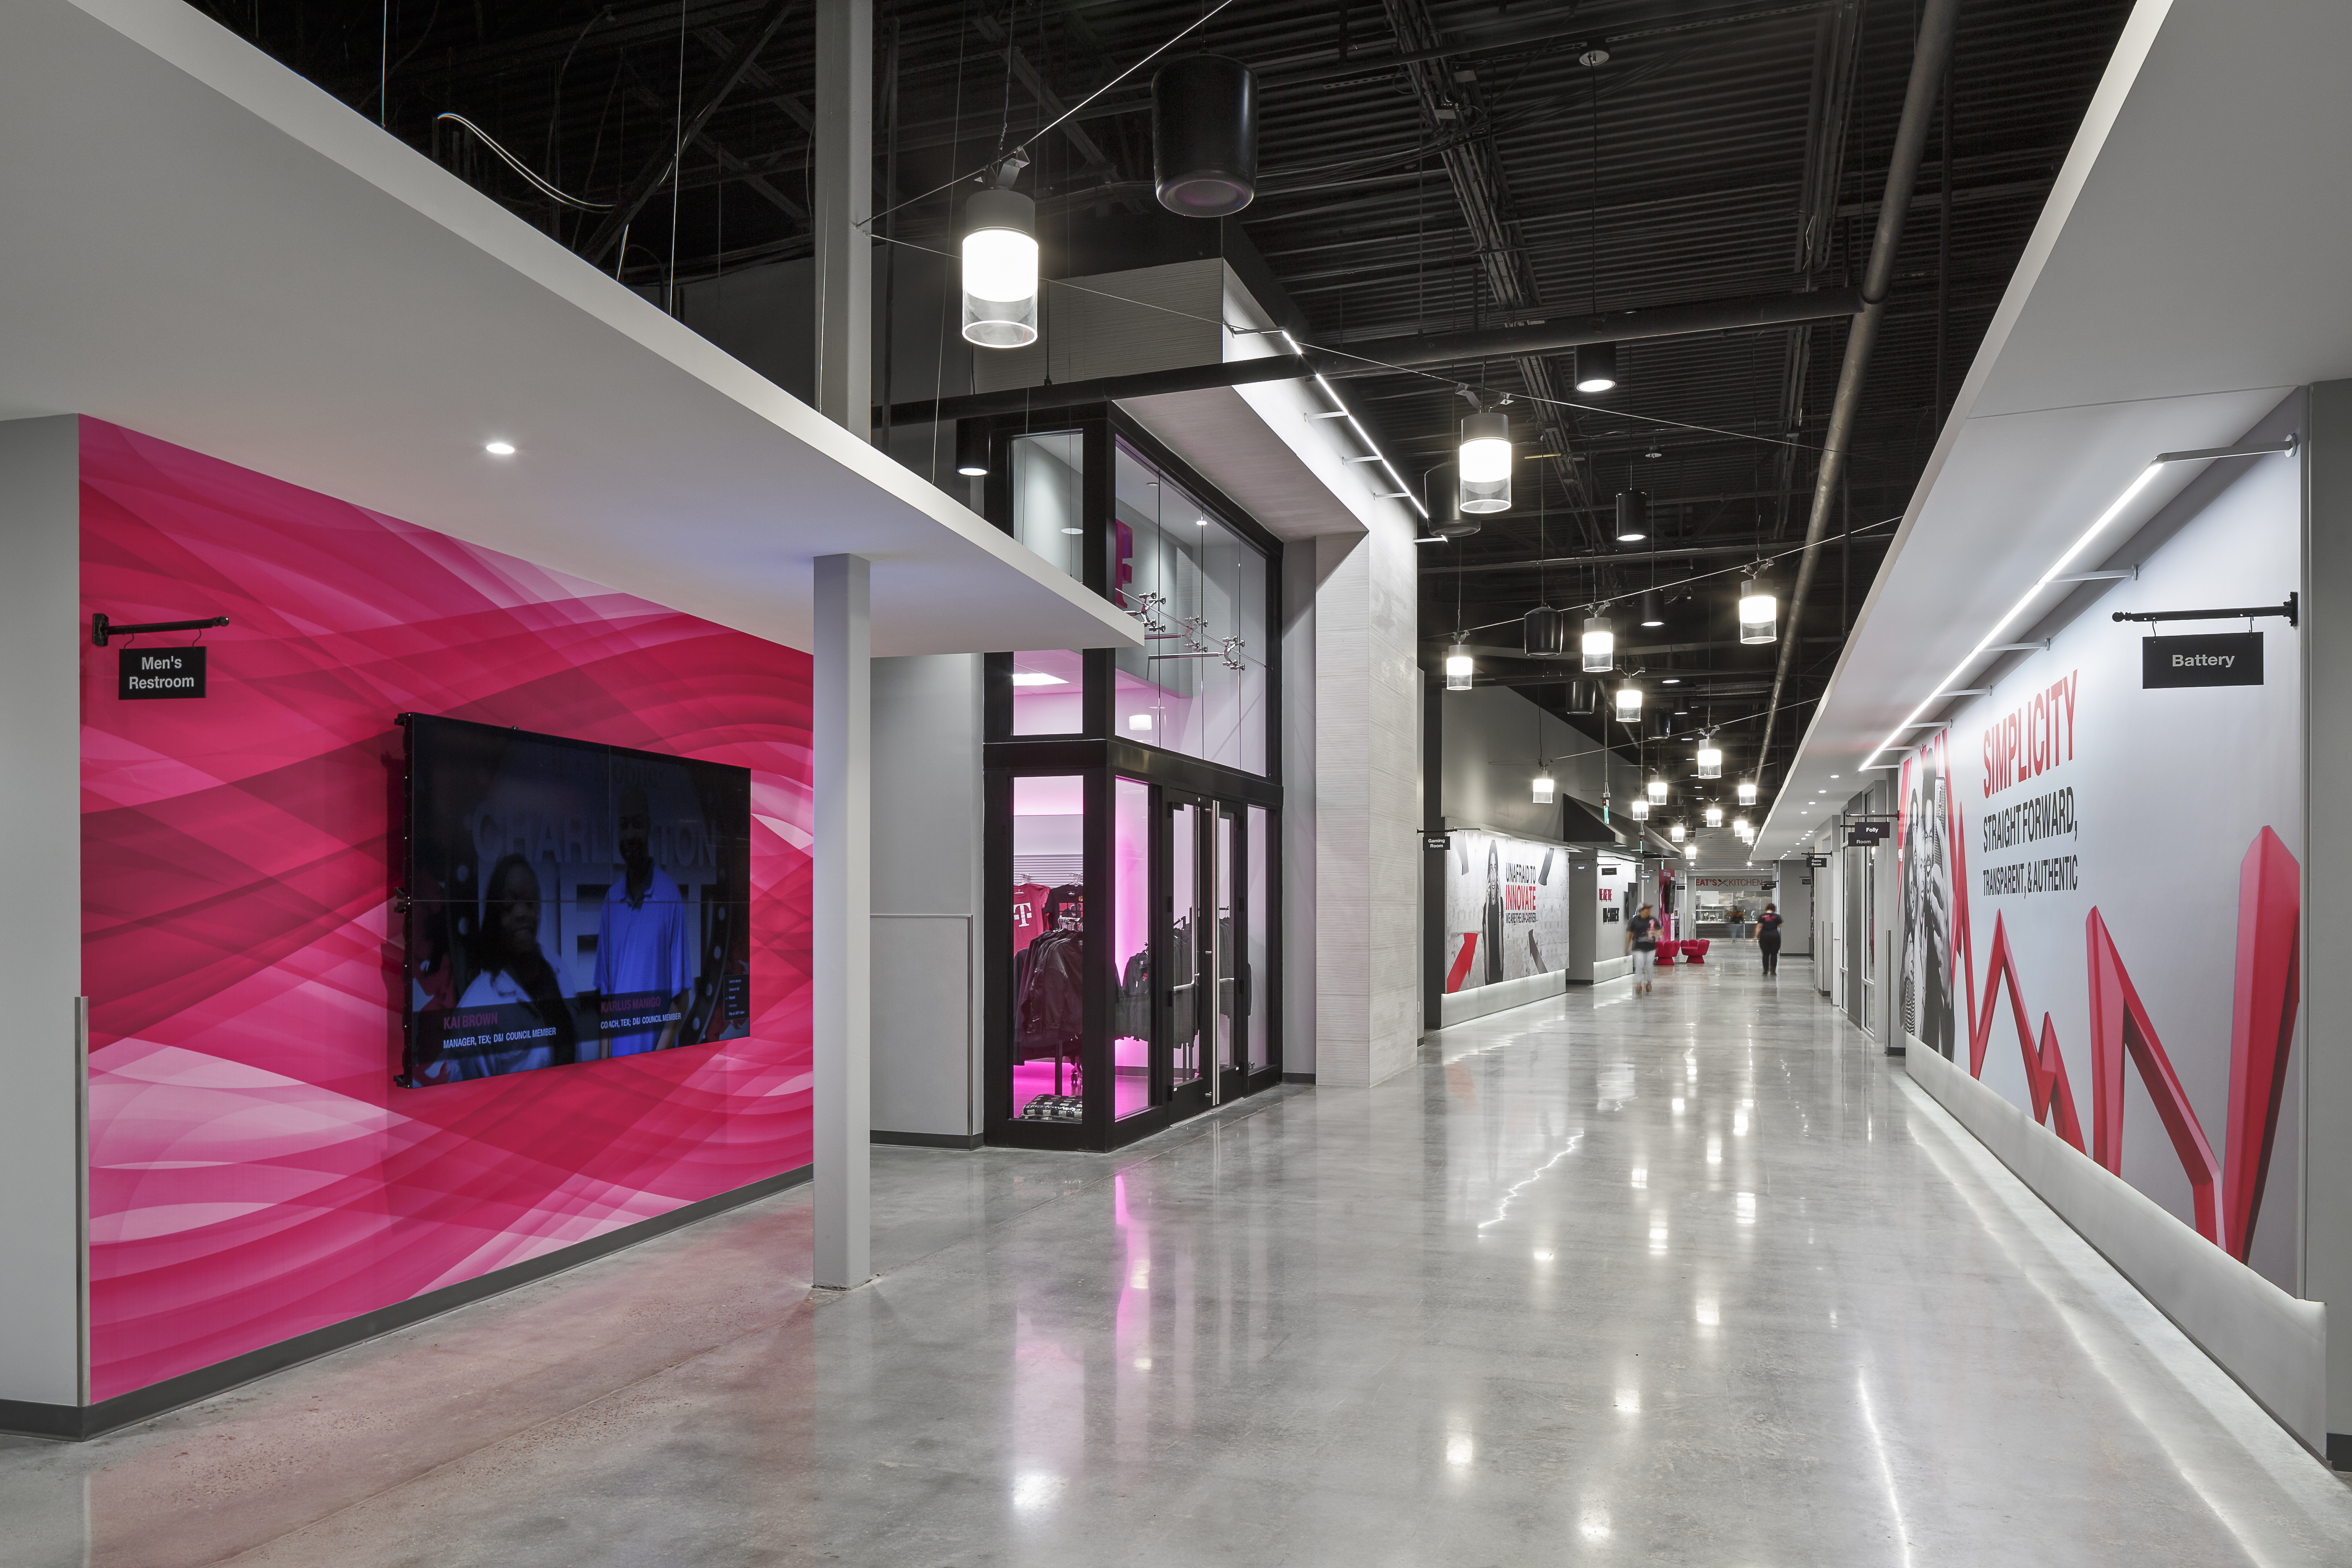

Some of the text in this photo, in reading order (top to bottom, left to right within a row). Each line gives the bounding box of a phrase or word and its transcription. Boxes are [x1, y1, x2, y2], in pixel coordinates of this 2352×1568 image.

[142, 656, 182, 670] Men's
[2173, 655, 2235, 668] Battery
[129, 676, 194, 689] Restroom
[1983, 669, 2077, 799] SIMPLICITY
[1983, 786, 2077, 853] STRAIGHT FORWARD,
[472, 800, 716, 866] CHARLTON
[1506, 862, 1536, 884] UNAFRAID TO
[1983, 854, 2078, 900] TRANSPARENT, & AUTHENTIC
[1506, 884, 1536, 911] INNOVATE
[601, 996, 661, 1013] KARLUS MANIGO
[443, 1012, 498, 1030] KAI BROWN
[633, 1017, 641, 1025] D&I
[642, 1015, 662, 1024] COUNCIL
[662, 1012, 681, 1021] MEMBER
[443, 1027, 556, 1049] MANAGER, TEX; D&I COUNCIL MEMBER
